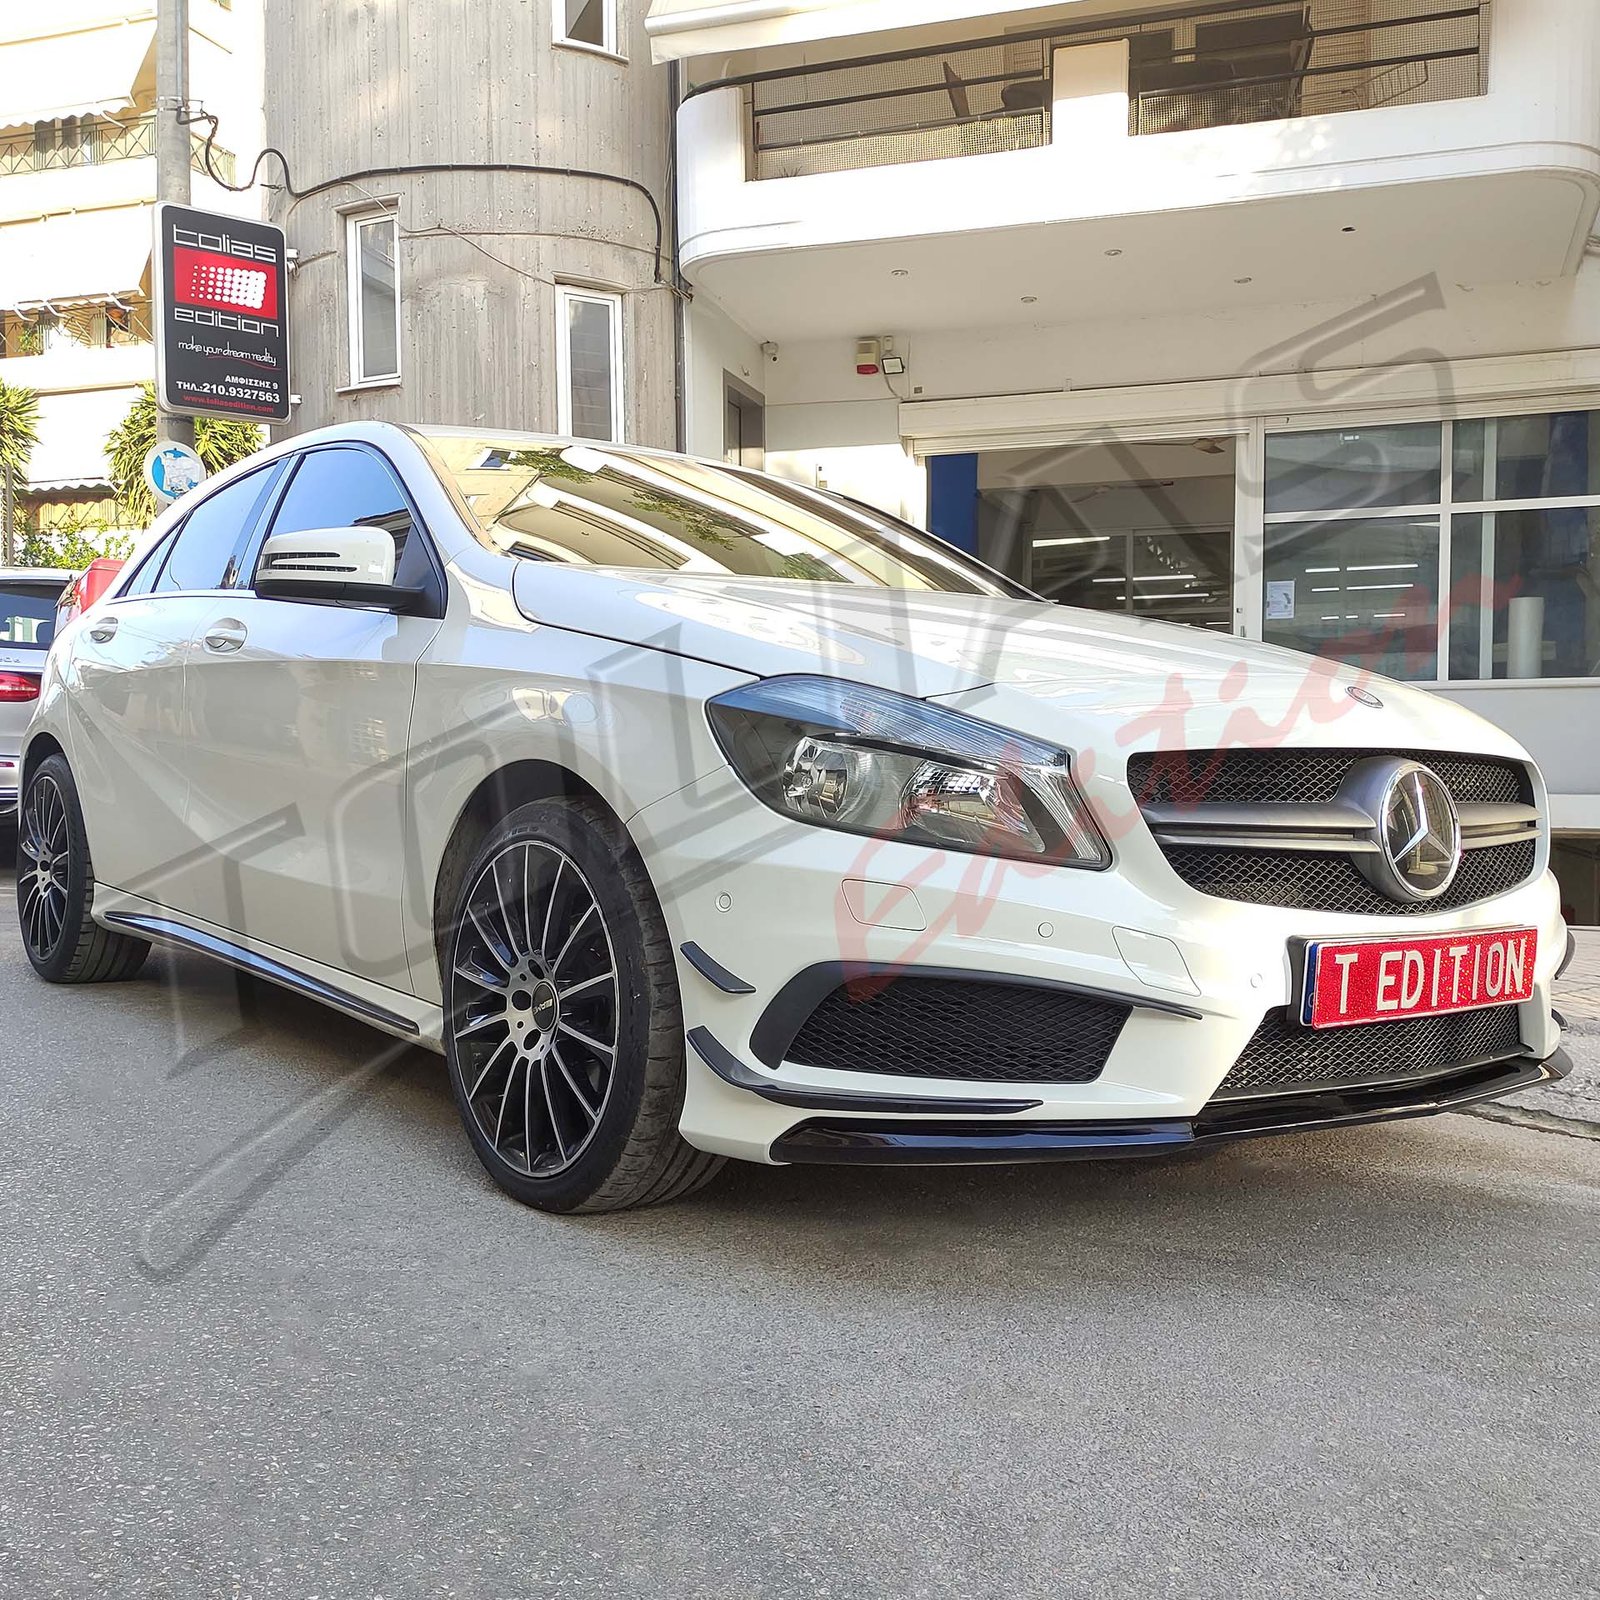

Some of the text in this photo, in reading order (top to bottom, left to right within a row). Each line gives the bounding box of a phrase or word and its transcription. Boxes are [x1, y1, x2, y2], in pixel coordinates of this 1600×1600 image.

[173, 224, 276, 263] tolias
[175, 308, 279, 338] edition
[178, 335, 277, 367] make your dream reality
[272, 382, 279, 390] 9
[1335, 938, 1527, 1014] T EDITION
